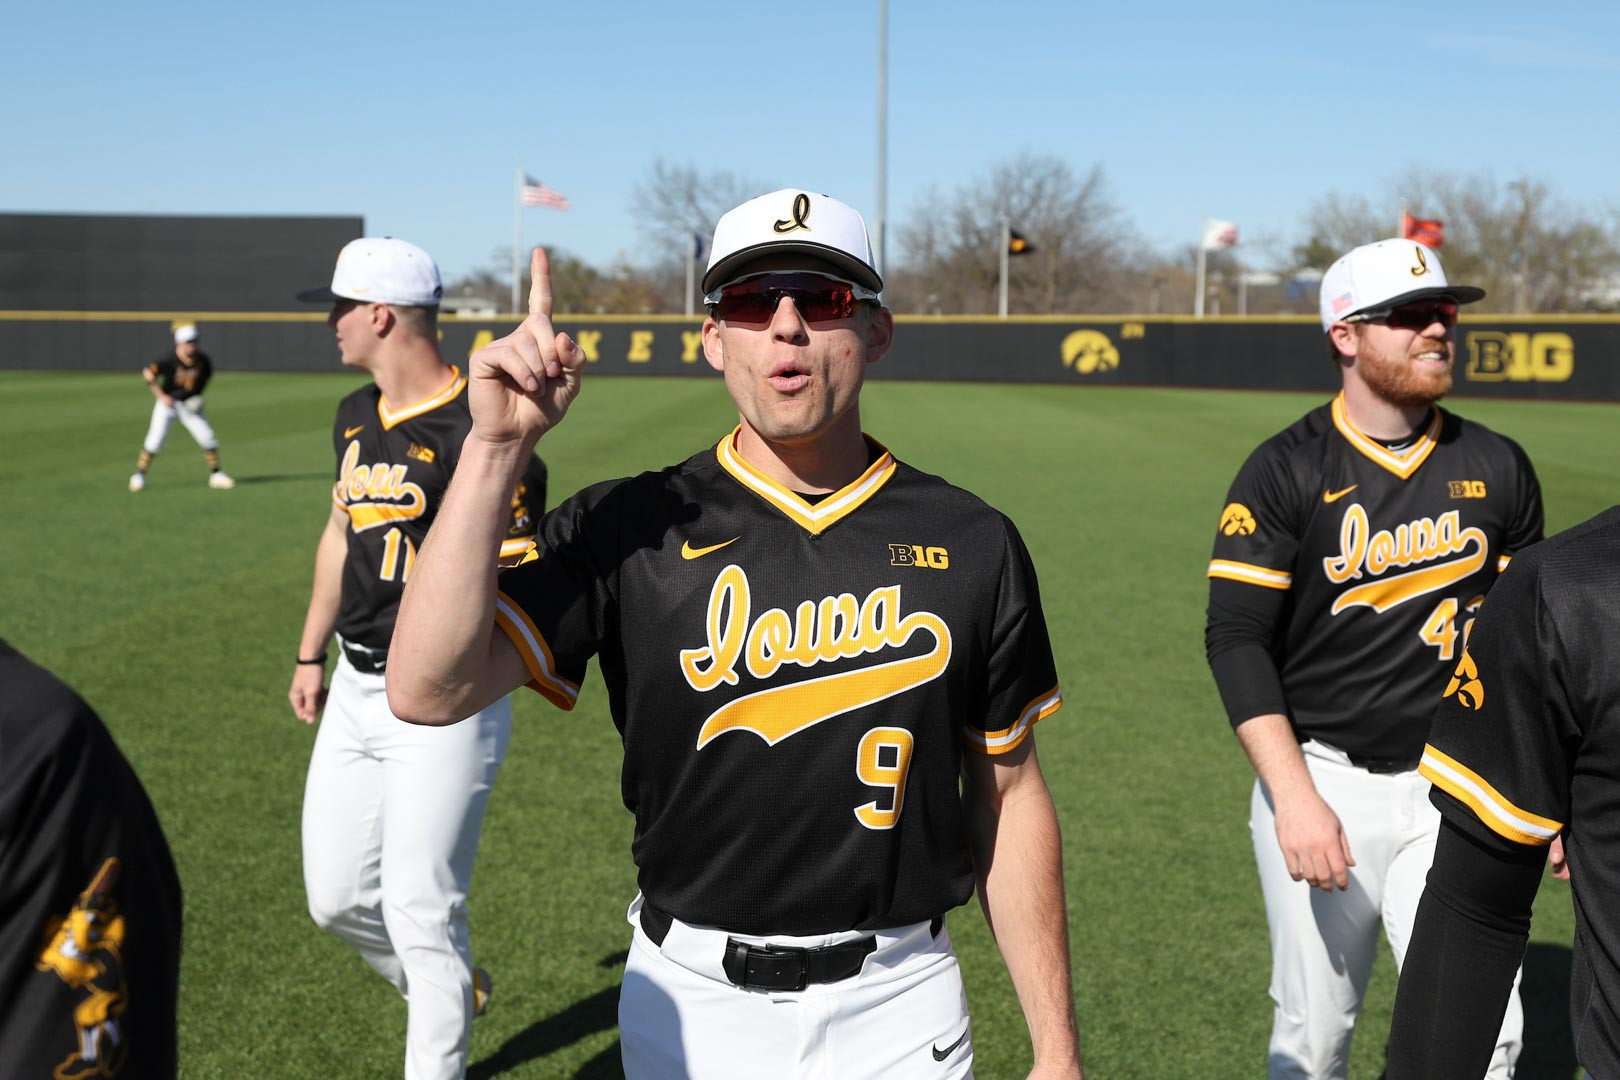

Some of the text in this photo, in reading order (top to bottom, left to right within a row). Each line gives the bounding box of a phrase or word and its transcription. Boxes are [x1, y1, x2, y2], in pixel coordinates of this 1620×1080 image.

[1323, 503, 1459, 584] Iowa
[680, 564, 901, 692] Iowa
[853, 726, 914, 830] 9
